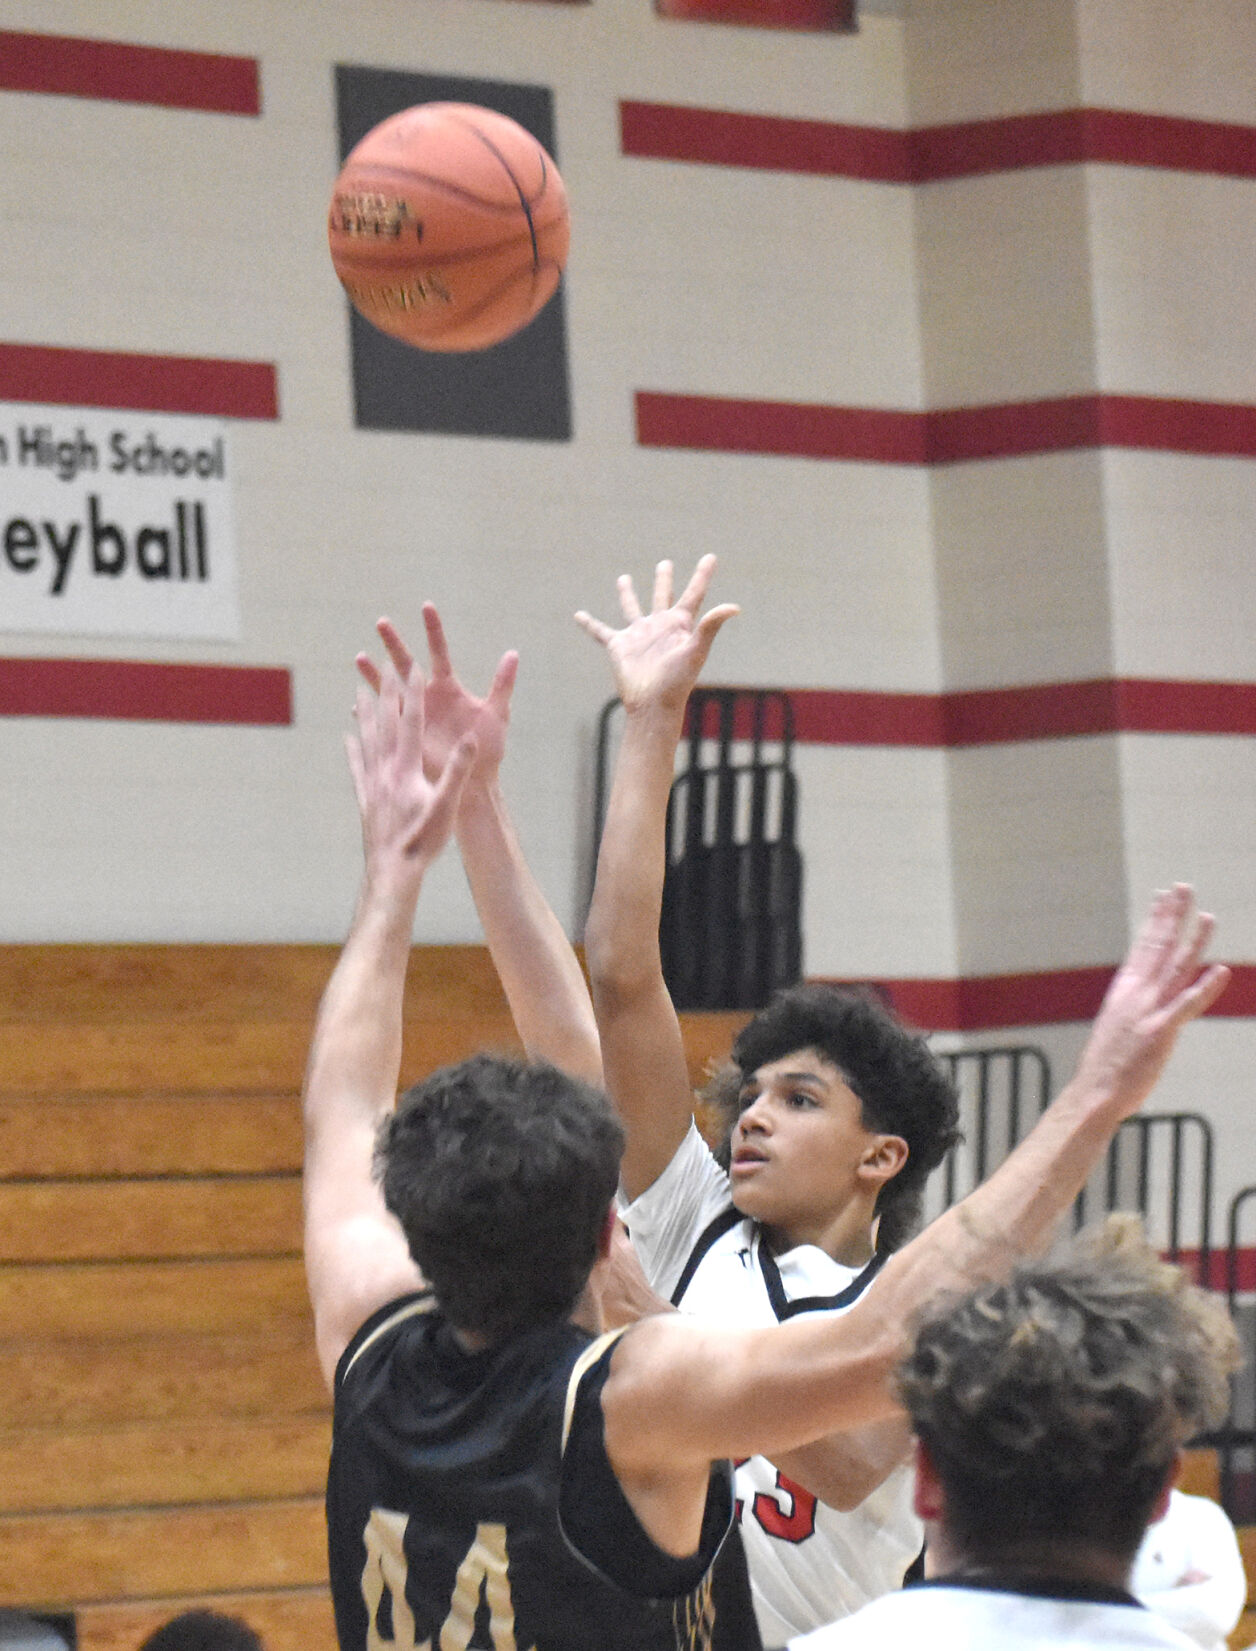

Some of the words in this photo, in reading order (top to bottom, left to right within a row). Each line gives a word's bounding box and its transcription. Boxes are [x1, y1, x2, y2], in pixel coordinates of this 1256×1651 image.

[18, 425, 98, 482] High
[110, 430, 225, 480] School
[4, 493, 209, 596] eyball
